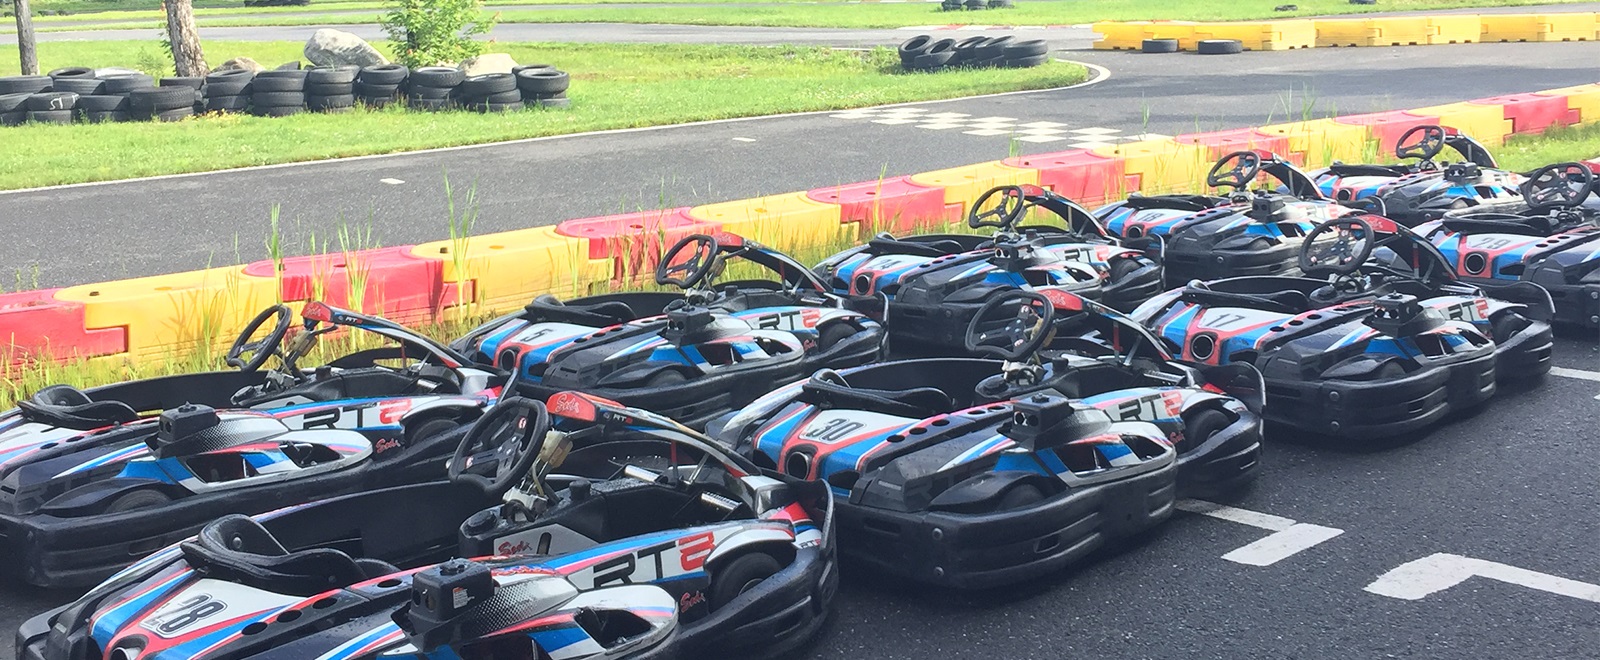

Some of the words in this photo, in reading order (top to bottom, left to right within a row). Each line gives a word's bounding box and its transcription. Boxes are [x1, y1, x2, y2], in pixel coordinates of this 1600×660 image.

[1471, 237, 1512, 249] 29
[759, 308, 821, 330] RT8
[1447, 298, 1489, 320] RT8
[1205, 313, 1246, 328] 17
[520, 328, 553, 342] 5
[302, 398, 413, 430] RT8
[1119, 389, 1183, 421] RT8
[805, 418, 867, 441] 30
[593, 531, 716, 590] RT8
[144, 593, 228, 634] 28
